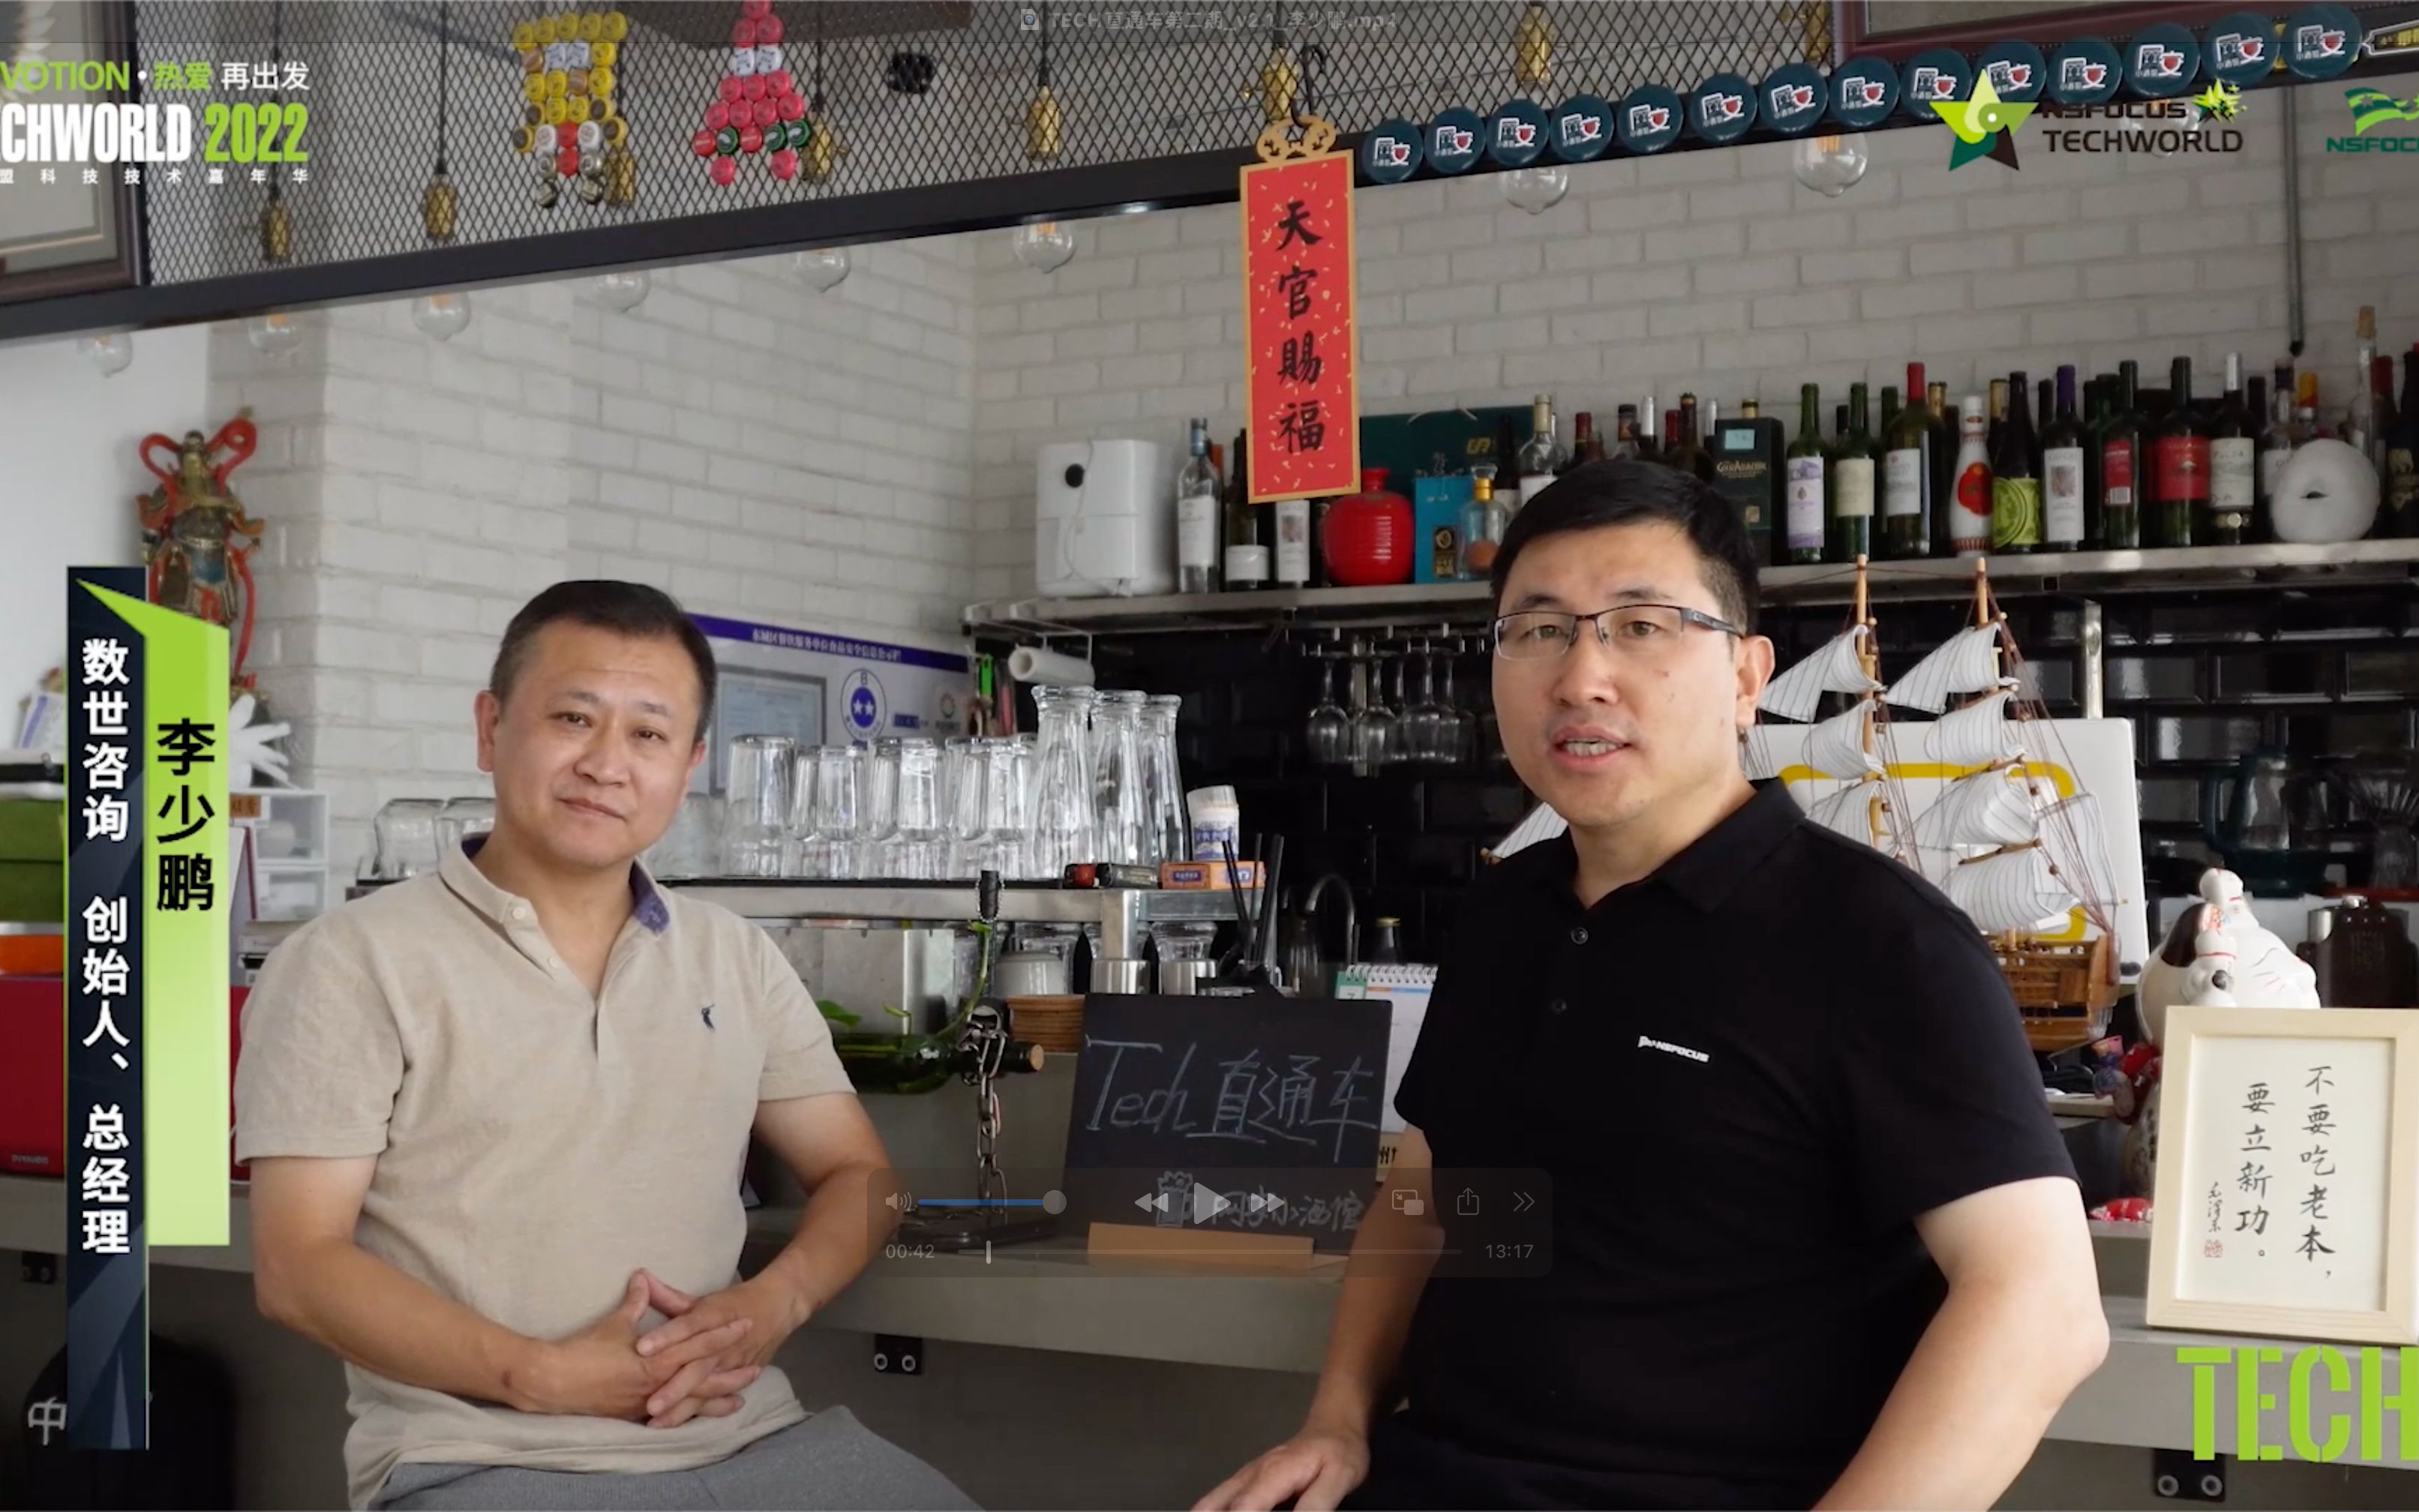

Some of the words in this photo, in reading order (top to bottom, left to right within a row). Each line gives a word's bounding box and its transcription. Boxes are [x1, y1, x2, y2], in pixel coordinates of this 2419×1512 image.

[1085, 1034, 1199, 1134] Tech
[1186, 1049, 1381, 1163] 直通车
[28, 1396, 67, 1446] 中
